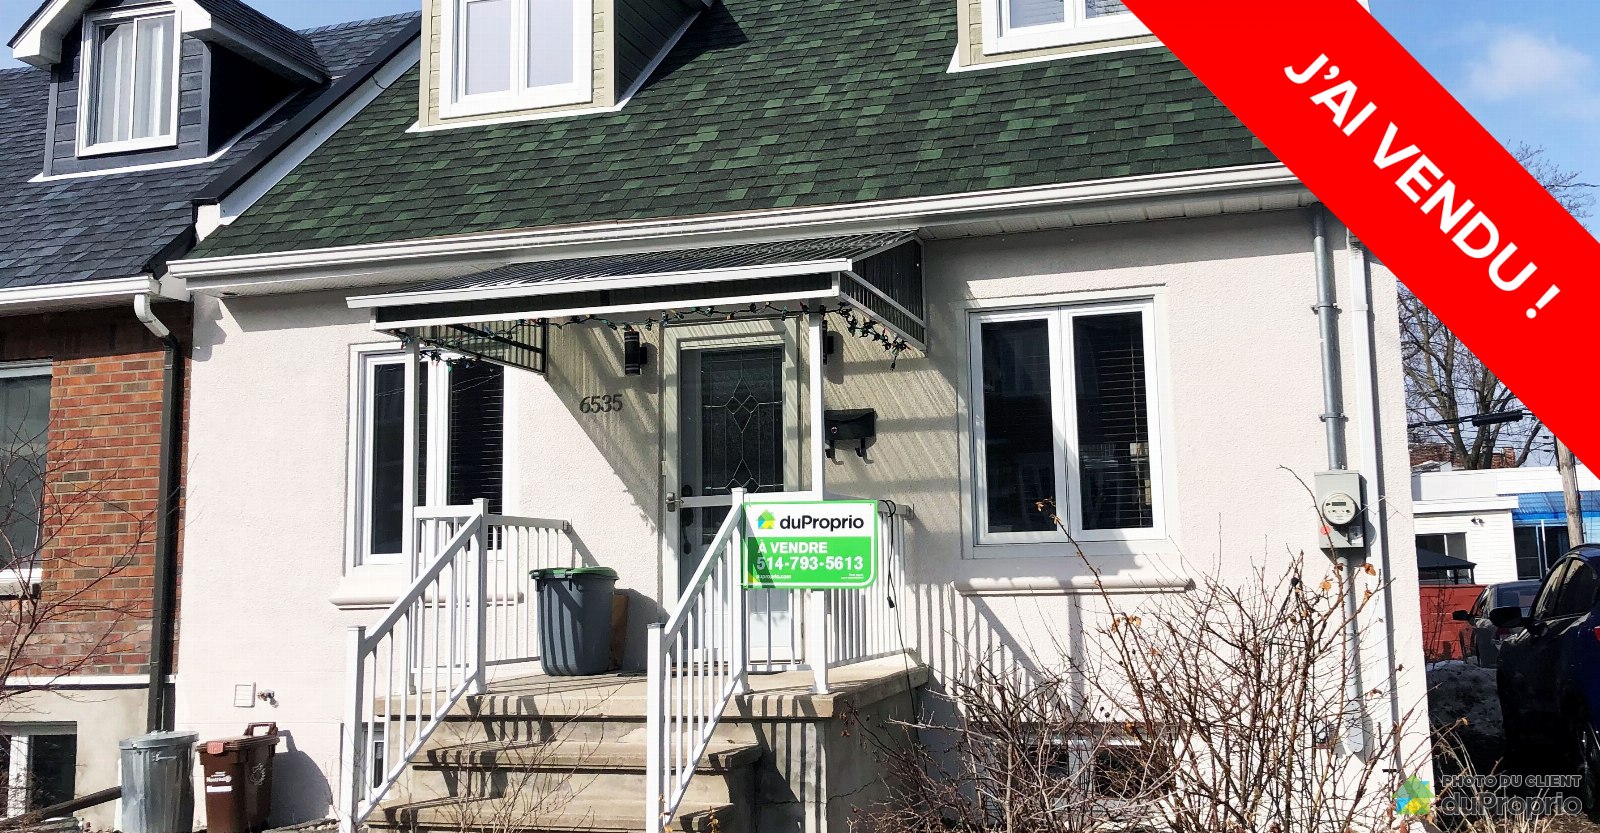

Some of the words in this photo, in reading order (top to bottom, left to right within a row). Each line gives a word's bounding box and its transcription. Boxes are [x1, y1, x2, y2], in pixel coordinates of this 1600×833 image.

[579, 394, 623, 413] 6535
[780, 514, 864, 532] duProprio
[758, 539, 767, 554] À
[771, 541, 828, 554] VENDRE
[756, 556, 864, 571] 514-793-5613
